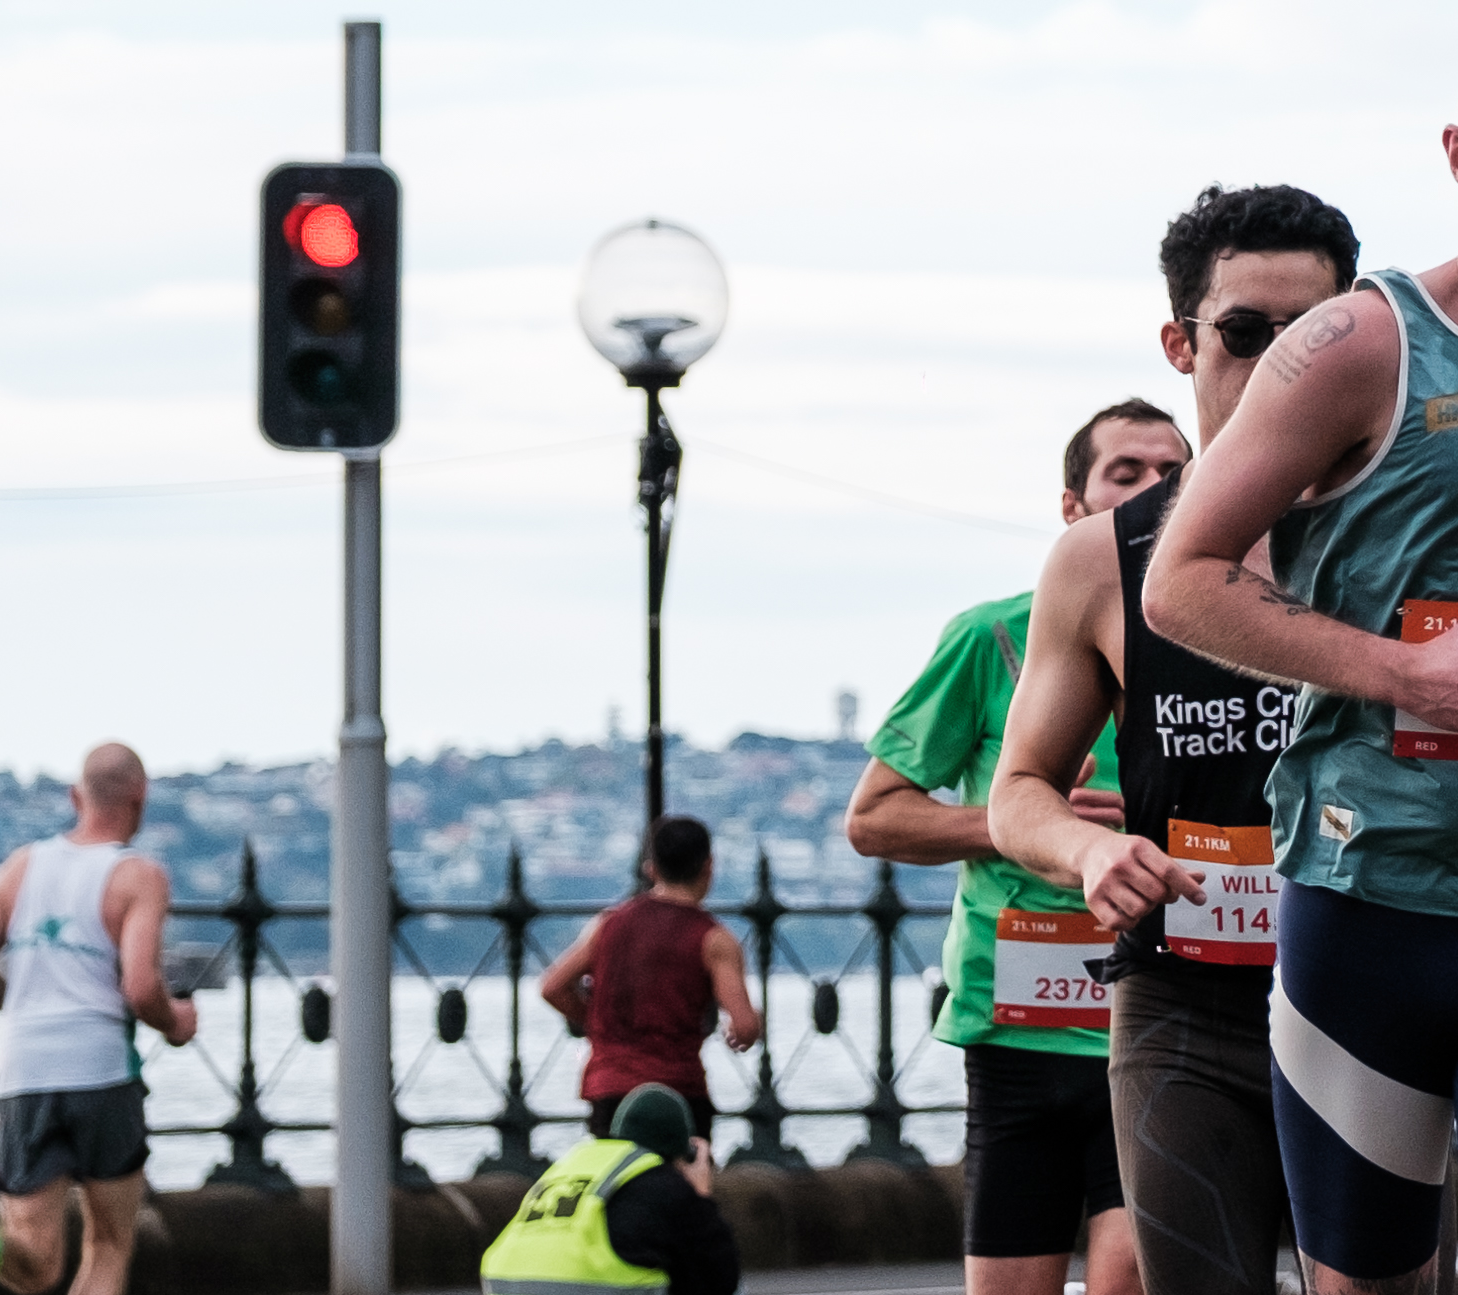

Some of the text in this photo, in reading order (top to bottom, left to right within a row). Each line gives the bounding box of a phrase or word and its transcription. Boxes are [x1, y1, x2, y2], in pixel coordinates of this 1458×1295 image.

[1155, 686, 1299, 728] Kings Cr
[1156, 723, 1247, 757] Track
[1415, 741, 1438, 751] RED
[1184, 834, 1230, 852] 21.1KM
[1222, 875, 1278, 894] WILL
[1211, 906, 1277, 934] 114
[1035, 977, 1106, 1001] 2376
